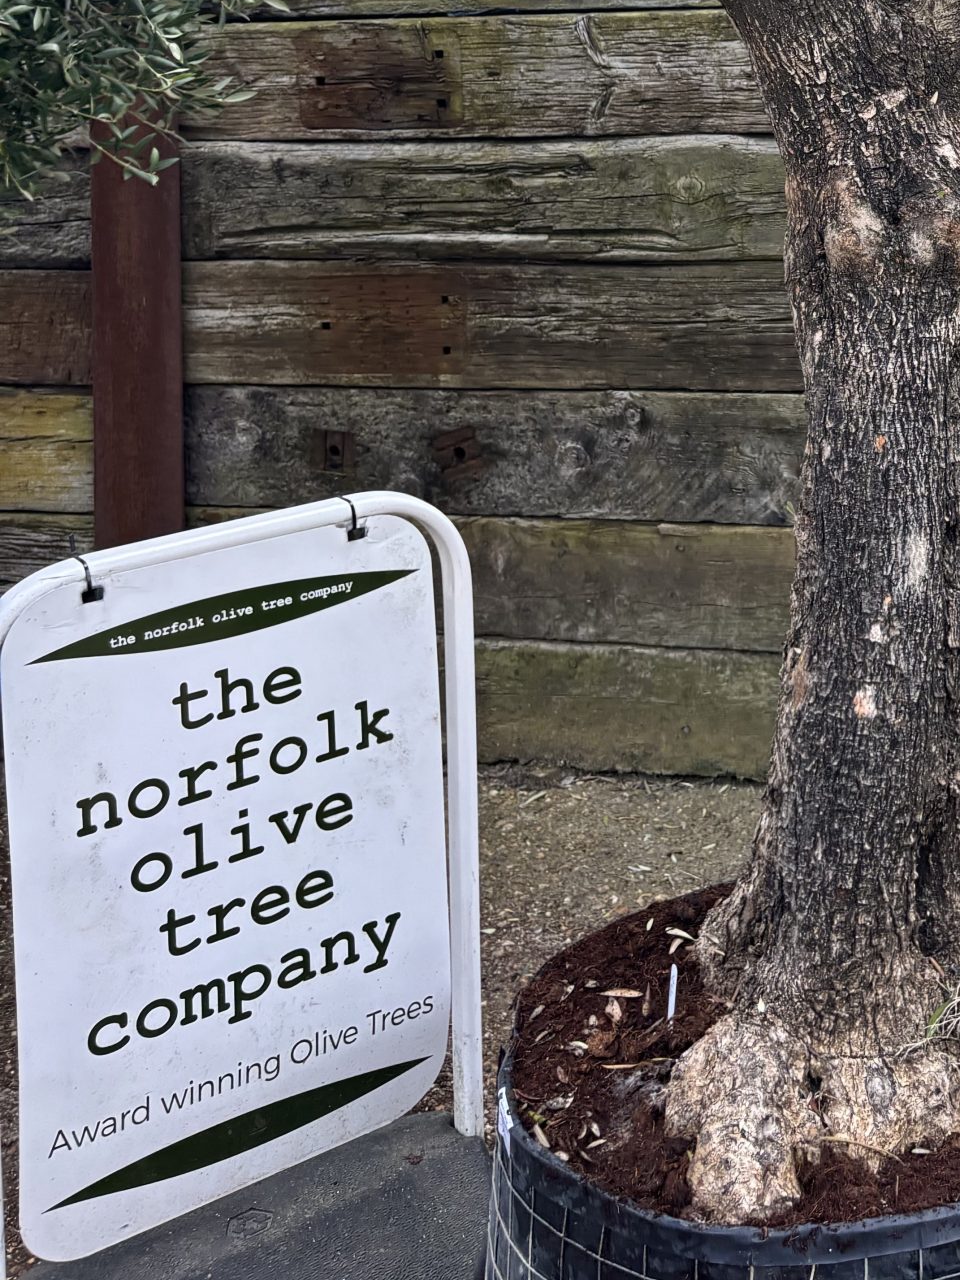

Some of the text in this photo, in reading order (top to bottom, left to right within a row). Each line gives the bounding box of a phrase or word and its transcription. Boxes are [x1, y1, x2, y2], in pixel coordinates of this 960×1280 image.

[109, 580, 353, 649] the norfolk olive tree company
[172, 666, 302, 730] the
[77, 701, 394, 838] norfolk
[131, 792, 354, 893] olive
[160, 869, 334, 957] tree
[88, 911, 401, 1056] company
[48, 994, 435, 1159] Award winning Olive Trees
